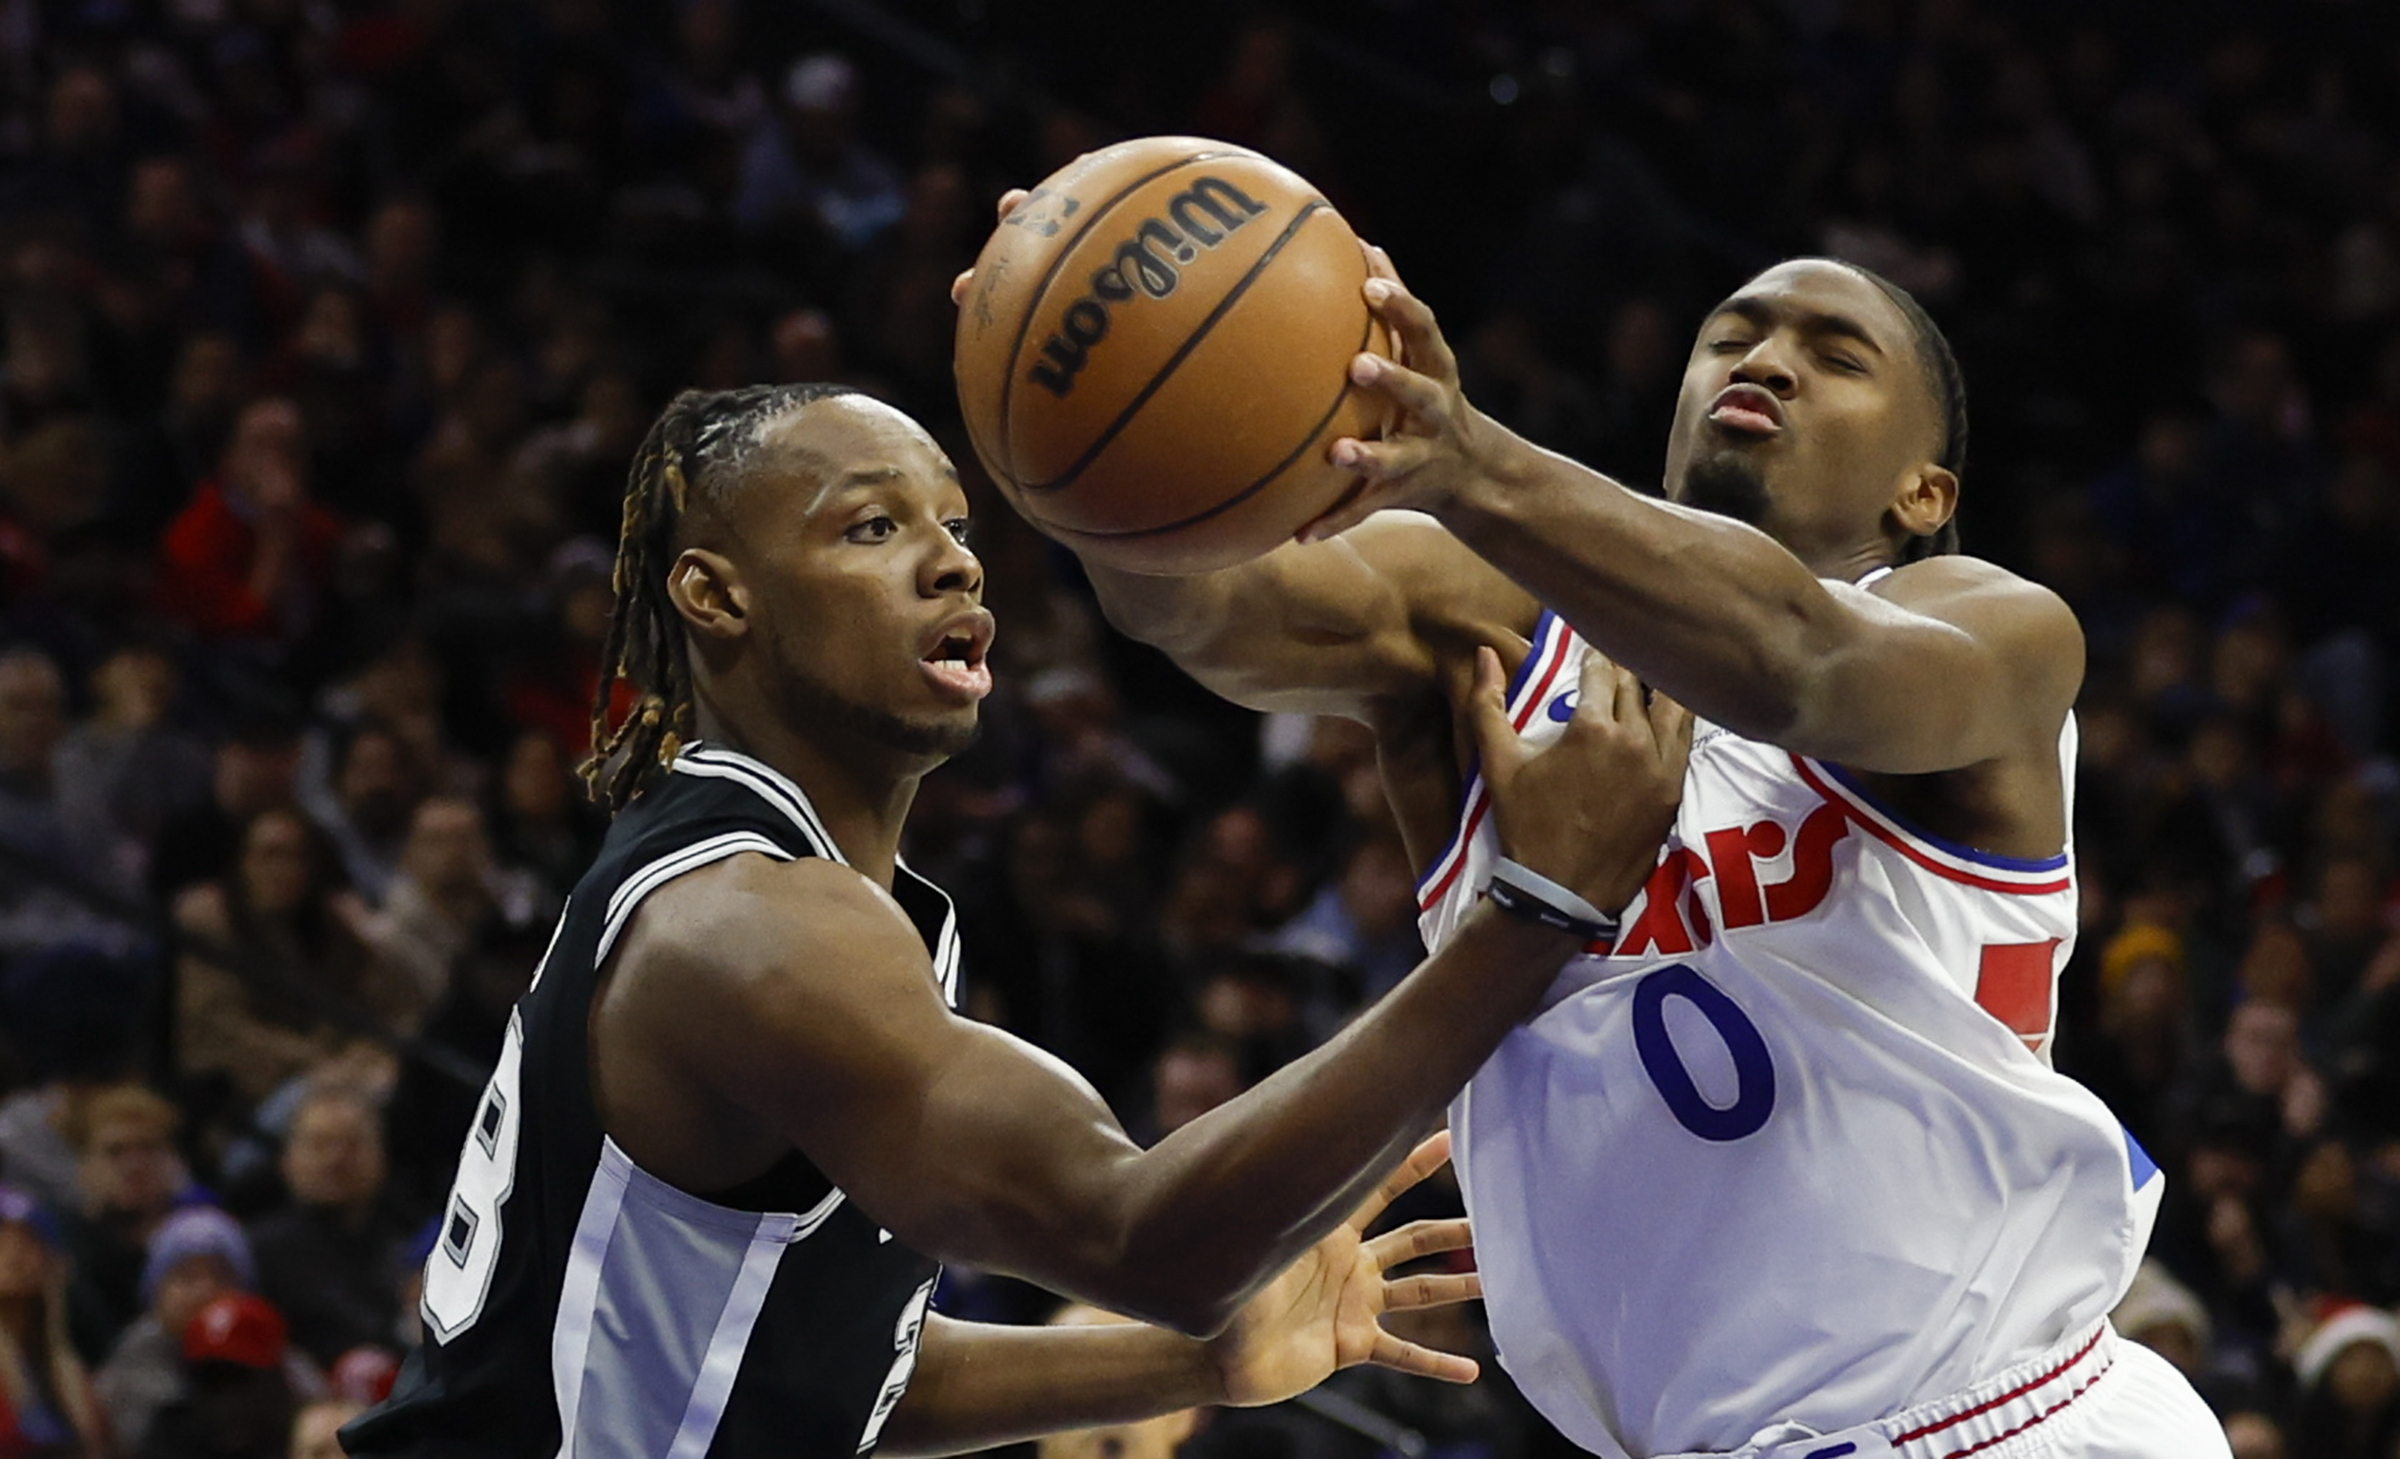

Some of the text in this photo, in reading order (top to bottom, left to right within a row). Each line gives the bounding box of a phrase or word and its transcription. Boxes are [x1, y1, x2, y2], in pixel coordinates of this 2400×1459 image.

[1029, 175, 1267, 397] Wilson
[1632, 962, 1776, 1142] 0
[420, 1003, 525, 1347] 8
